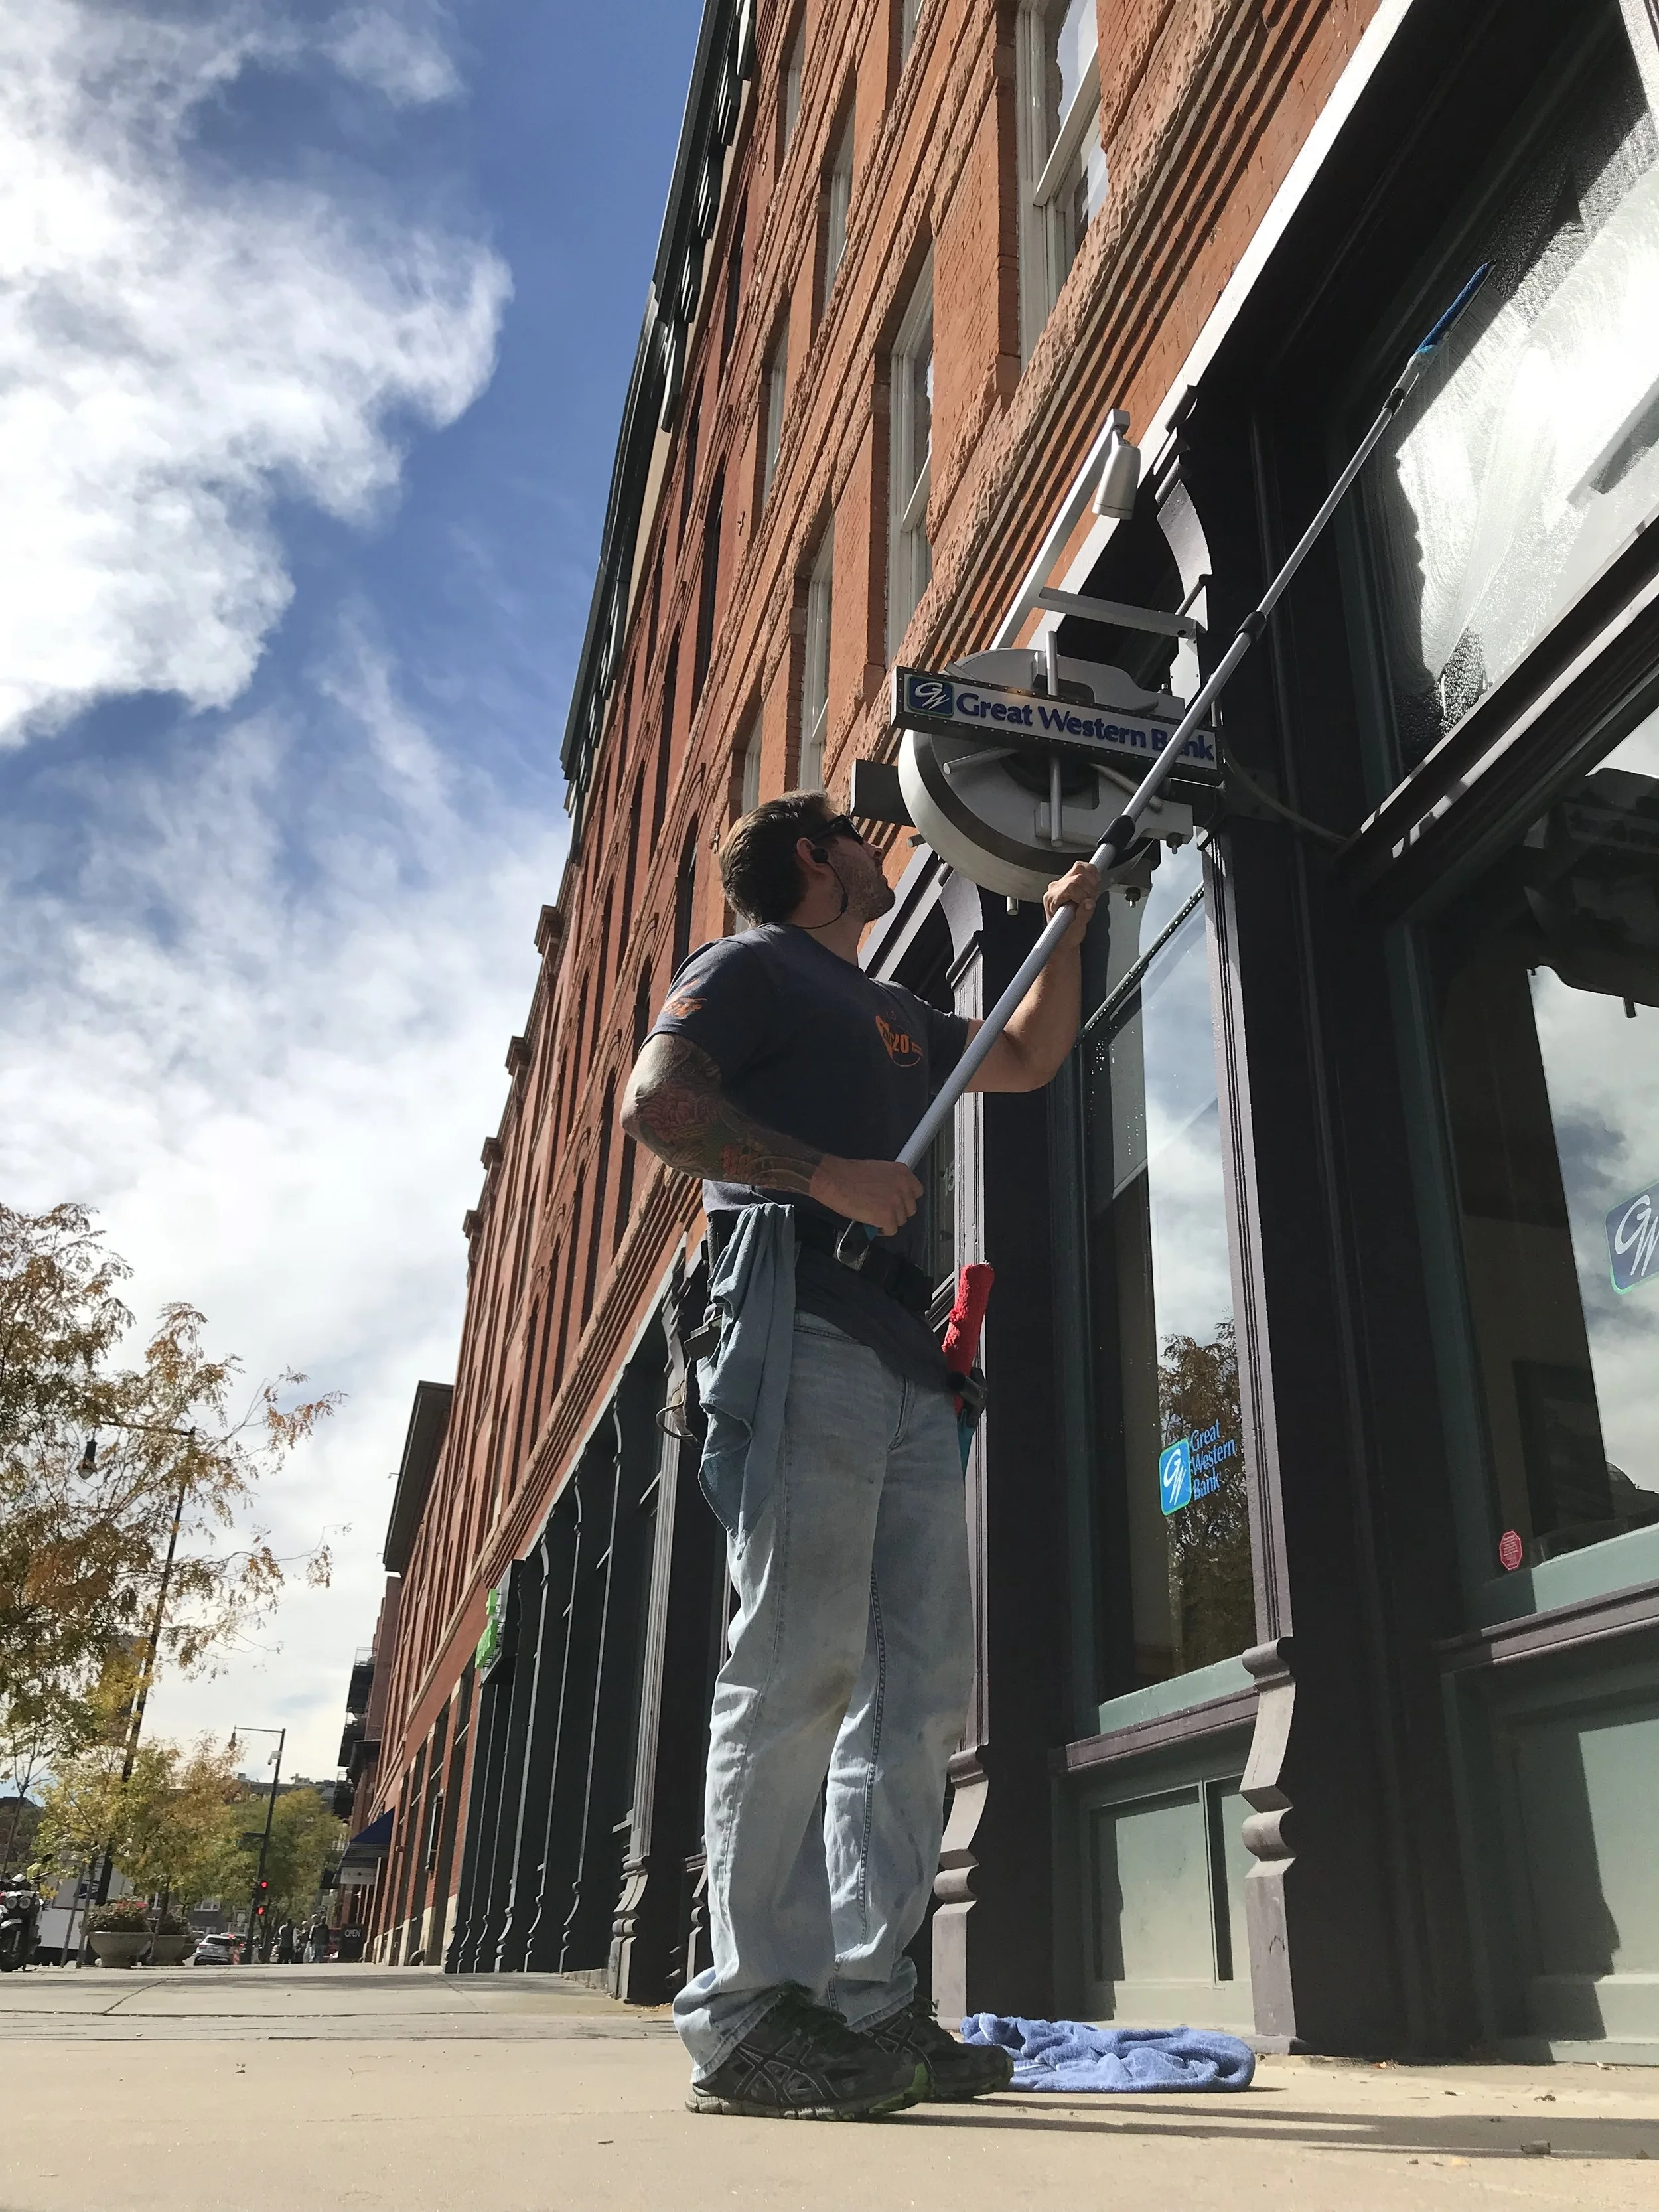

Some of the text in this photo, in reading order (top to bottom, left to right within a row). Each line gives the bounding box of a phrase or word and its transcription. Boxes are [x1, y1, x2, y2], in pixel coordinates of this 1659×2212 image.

[956, 692, 1034, 727] Great
[1037, 705, 1147, 749] Western
[1151, 728, 1215, 761] Bnk
[1190, 1418, 1221, 1452] Great
[1190, 1439, 1236, 1475] Western
[1192, 1467, 1221, 1501] Bank
